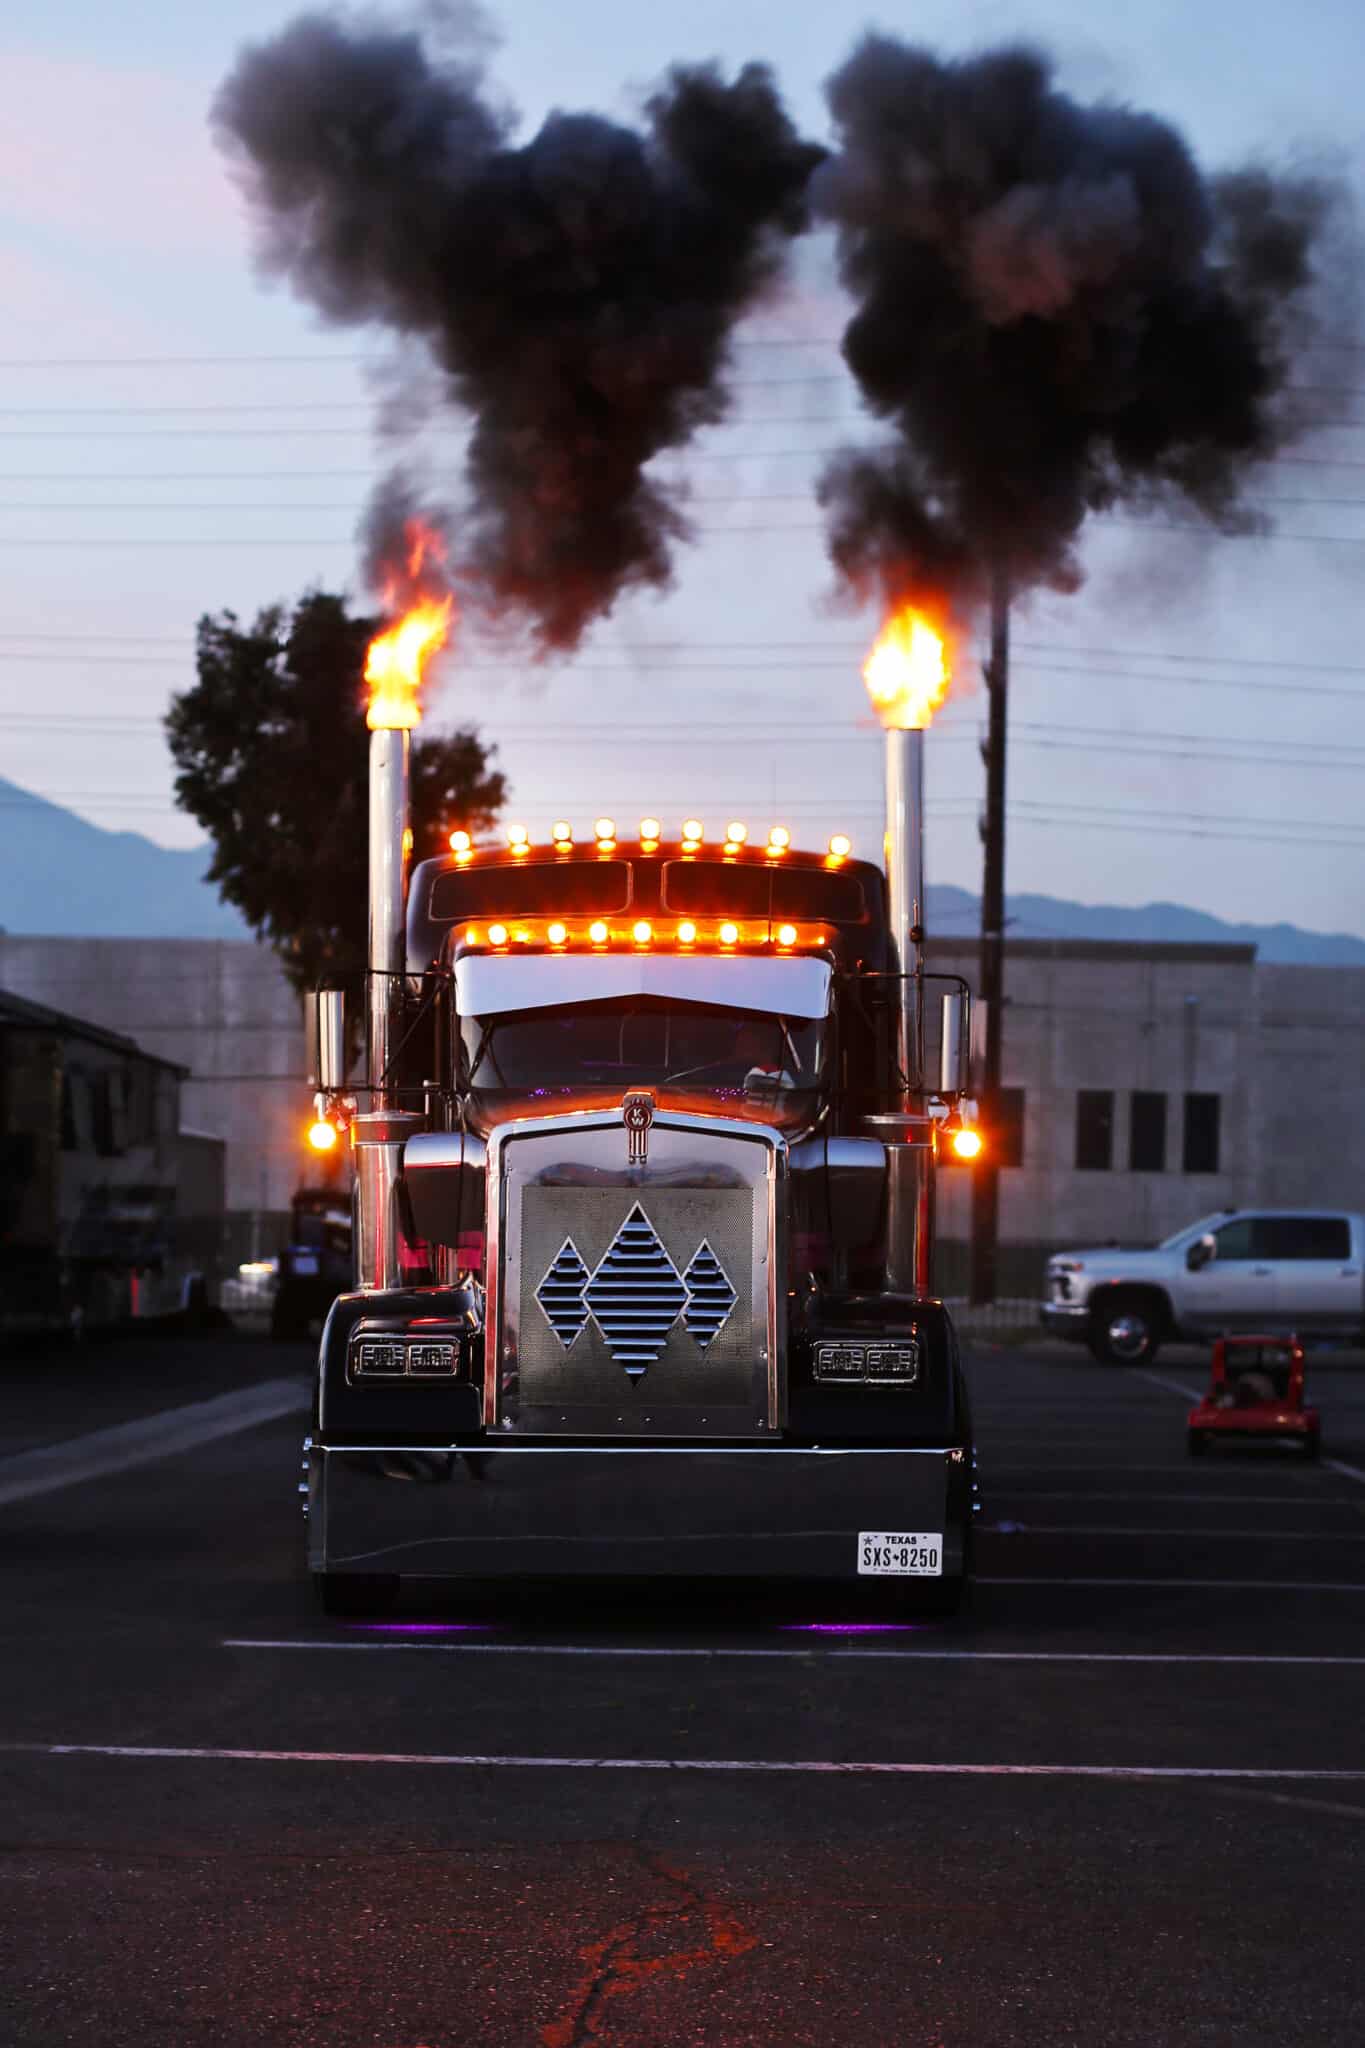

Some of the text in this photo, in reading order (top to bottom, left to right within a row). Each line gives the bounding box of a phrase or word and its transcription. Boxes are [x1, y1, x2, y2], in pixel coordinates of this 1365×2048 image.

[633, 1108, 642, 1117] K
[631, 1117, 644, 1126] W
[885, 1536, 917, 1545] TEXAS
